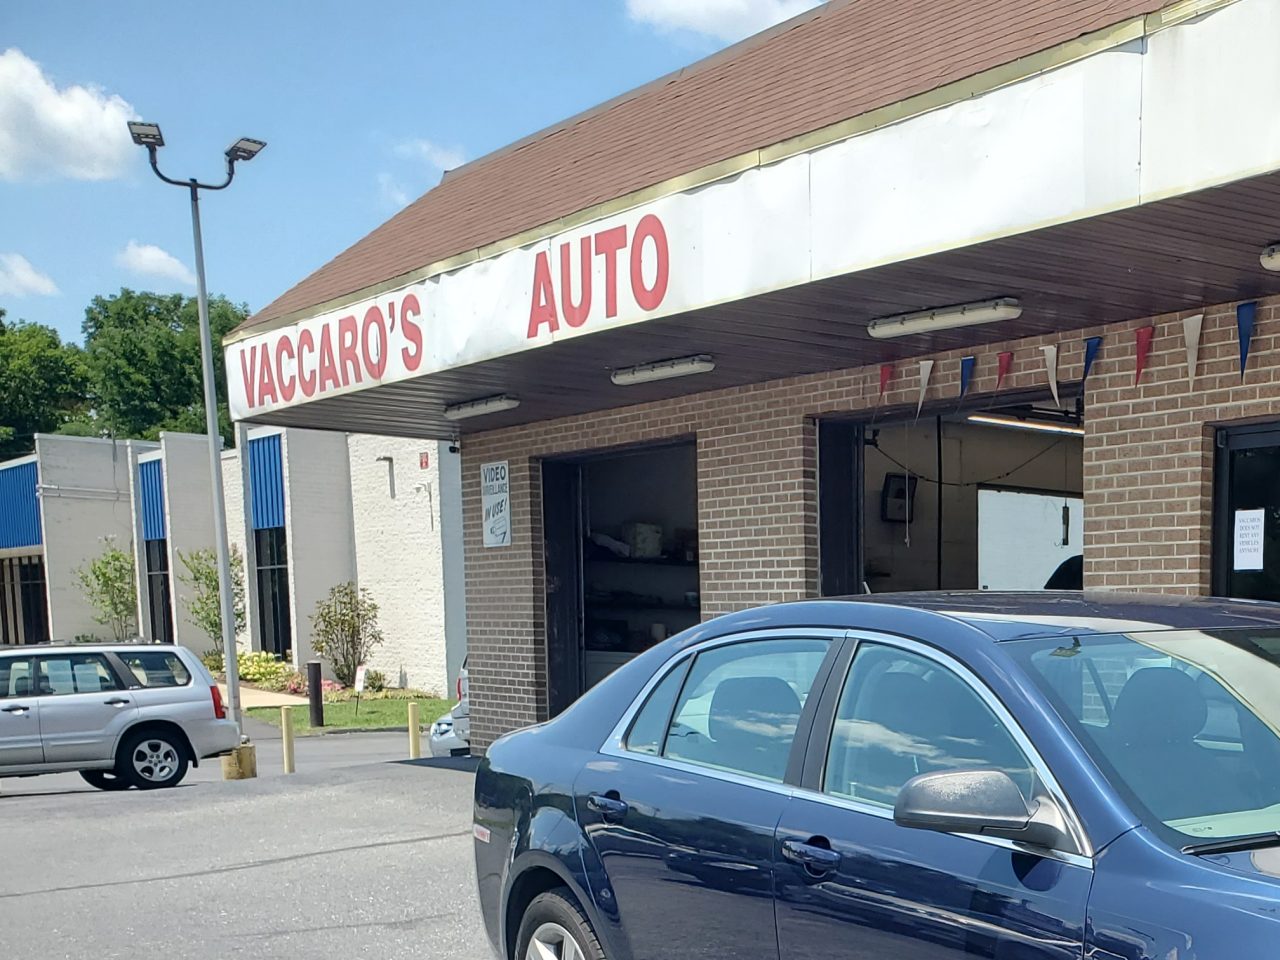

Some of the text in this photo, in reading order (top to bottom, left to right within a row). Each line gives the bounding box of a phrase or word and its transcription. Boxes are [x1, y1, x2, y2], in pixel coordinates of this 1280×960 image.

[239, 213, 670, 409] VACCARO'S AUTO
[483, 465, 506, 484] VIDEO
